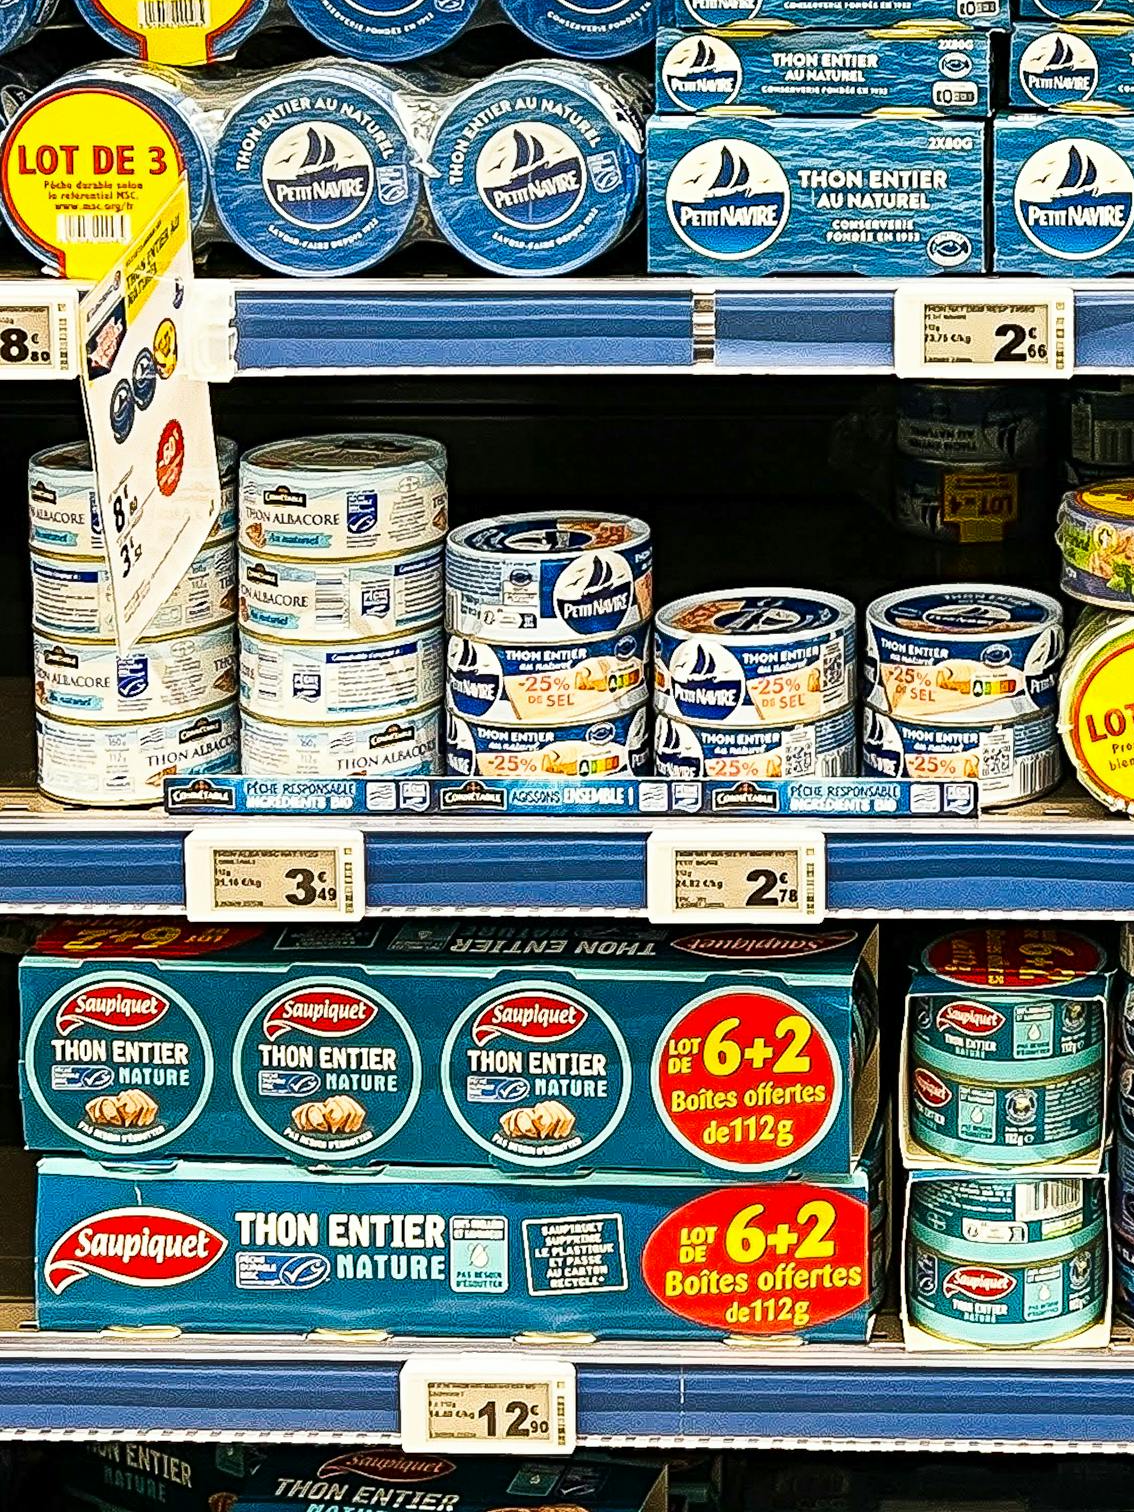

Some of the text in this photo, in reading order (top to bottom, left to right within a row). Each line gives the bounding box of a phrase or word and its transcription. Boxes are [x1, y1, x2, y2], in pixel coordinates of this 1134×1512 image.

[19, 145, 166, 173] LOT DE 3
[798, 170, 948, 189] THON ENTIER
[817, 191, 931, 210] AU NATUREL
[994, 324, 1047, 362] 2 66
[275, 512, 339, 527] ALBACORE
[506, 648, 588, 662] THON ENTIER
[518, 678, 570, 693] -25%
[285, 868, 336, 905] 3 49
[746, 869, 798, 906] 2 78
[75, 995, 157, 1017] Saupiquet
[283, 1000, 366, 1021] Saupiquet
[52, 1039, 189, 1065] THON ENTIER
[259, 1044, 396, 1070] THON ENTIER
[668, 1017, 812, 1076] DE 6+2
[668, 1038, 701, 1056] LOT
[118, 1067, 190, 1086] NATURE
[326, 1073, 397, 1092] NATURE
[671, 1085, 825, 1112] Boîtes offertes
[235, 1212, 318, 1246] THON
[329, 1214, 445, 1248] ENTIER
[680, 1201, 836, 1263] DE 6+2
[680, 1226, 716, 1245] LOT
[74, 1228, 210, 1263] Saupiquet
[336, 1255, 445, 1279] NATURE
[666, 1265, 861, 1296] Boîtes offertes
[478, 1401, 548, 1437] 12 90
[273, 1478, 459, 1512] THON ENTIER
